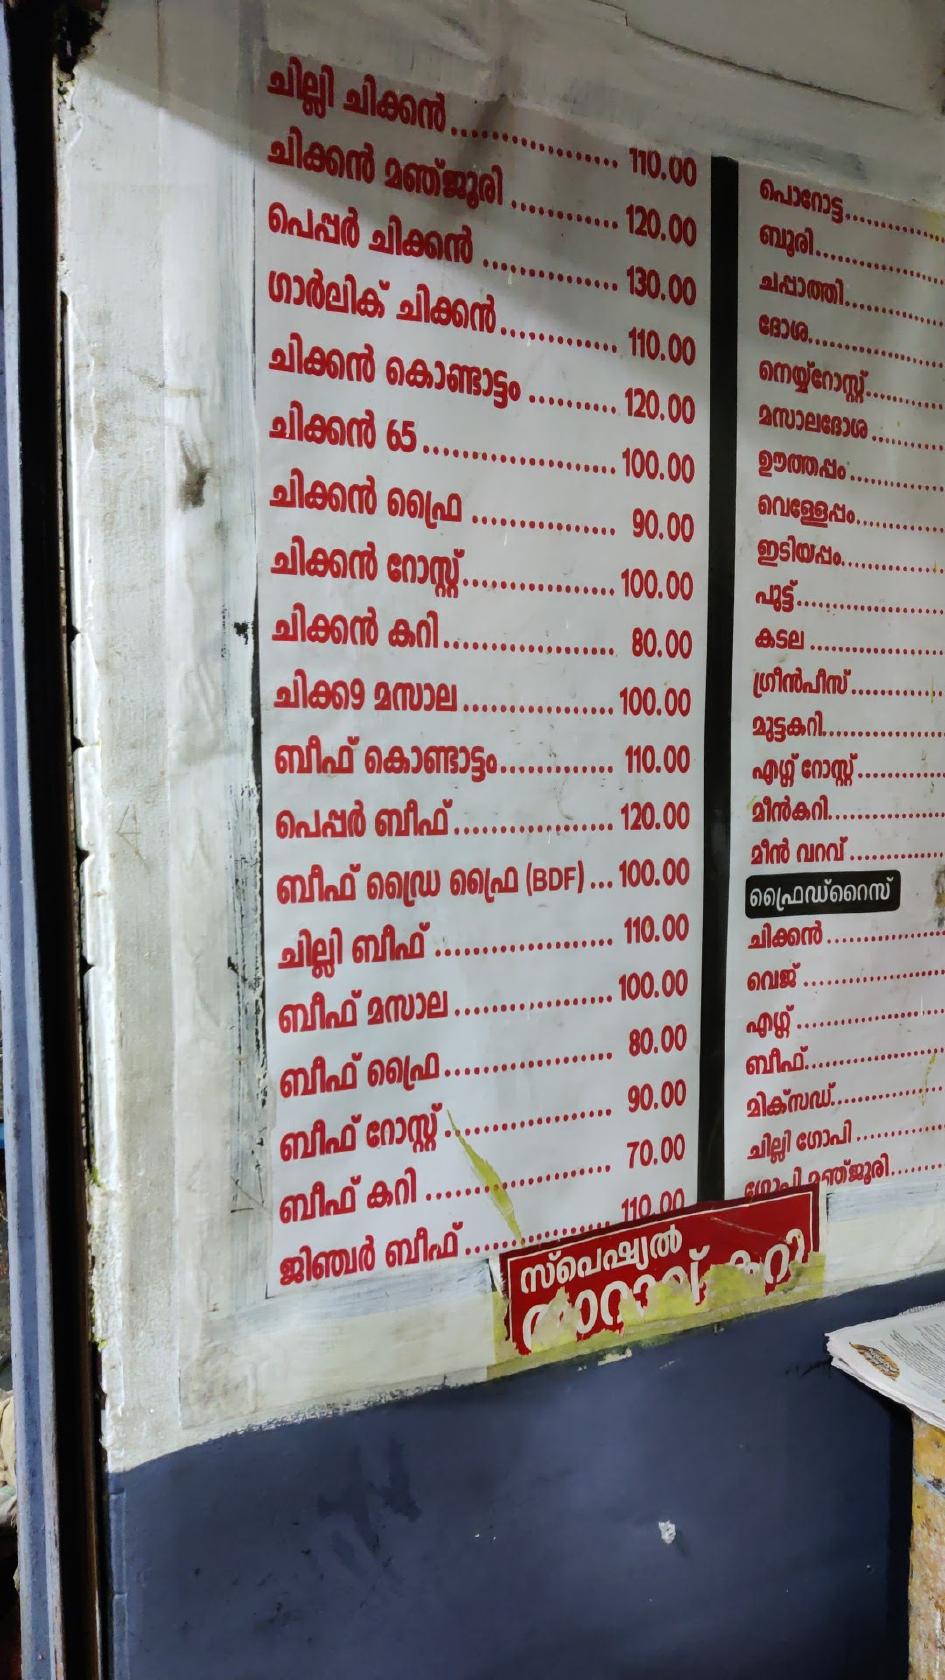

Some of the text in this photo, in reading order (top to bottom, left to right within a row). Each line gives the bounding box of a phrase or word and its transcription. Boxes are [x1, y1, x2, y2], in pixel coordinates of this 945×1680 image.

[267, 56, 697, 187] ചില്ലി ചിക്കൻ 110.00
[267, 126, 376, 184] ചിക്കൻ
[626, 204, 697, 247] 120.00
[267, 200, 697, 305] പെപ്പർ ചിക്കൻ 130.00
[267, 267, 697, 366] ഗാർലിക് ചിക്കൻ 110.00
[268, 331, 376, 384] ചിക്കൻ
[624, 387, 696, 426] 120.00
[268, 400, 695, 485] ചിക്കൻ 65 100.00
[269, 467, 377, 517] ചിക്കൻ
[632, 507, 695, 543] 90.00
[270, 535, 378, 582] ചിക്കൻ
[620, 568, 694, 602] 100.00
[272, 602, 694, 661] ചിക്കൻ കറി 80.00
[754, 627, 805, 651] കടല
[374, 681, 458, 712] മസാല
[619, 686, 692, 717] 100.00
[274, 735, 361, 775] ബീഫ്
[624, 744, 692, 774] 110.00
[275, 799, 691, 840] പെപ്പർ ബീഫ് 120.00
[751, 835, 848, 865] മീൻ വറവ്
[277, 863, 362, 905] ബീഫ്
[526, 860, 584, 896] (BDF)
[618, 858, 691, 888] 100.00
[278, 912, 690, 979] ചില്ലി ബീഫ് 110.00
[747, 919, 824, 950] ചിക്കൻ
[278, 968, 689, 1035] ബീഫ് മസാല 100.00
[746, 961, 800, 992] വെജ്
[279, 1051, 363, 1099] ബീഫ്
[628, 1023, 688, 1059] 80.00
[745, 1045, 809, 1077] ബീഫ്
[279, 1113, 363, 1163] ബീഫ്
[627, 1078, 688, 1114] 90.00
[796, 1119, 853, 1152] ഗോപി
[279, 1133, 686, 1225] ബീഫ് കറി 70.00
[384, 1221, 464, 1269] ബീഫ്
[621, 1187, 685, 1222] 11000
